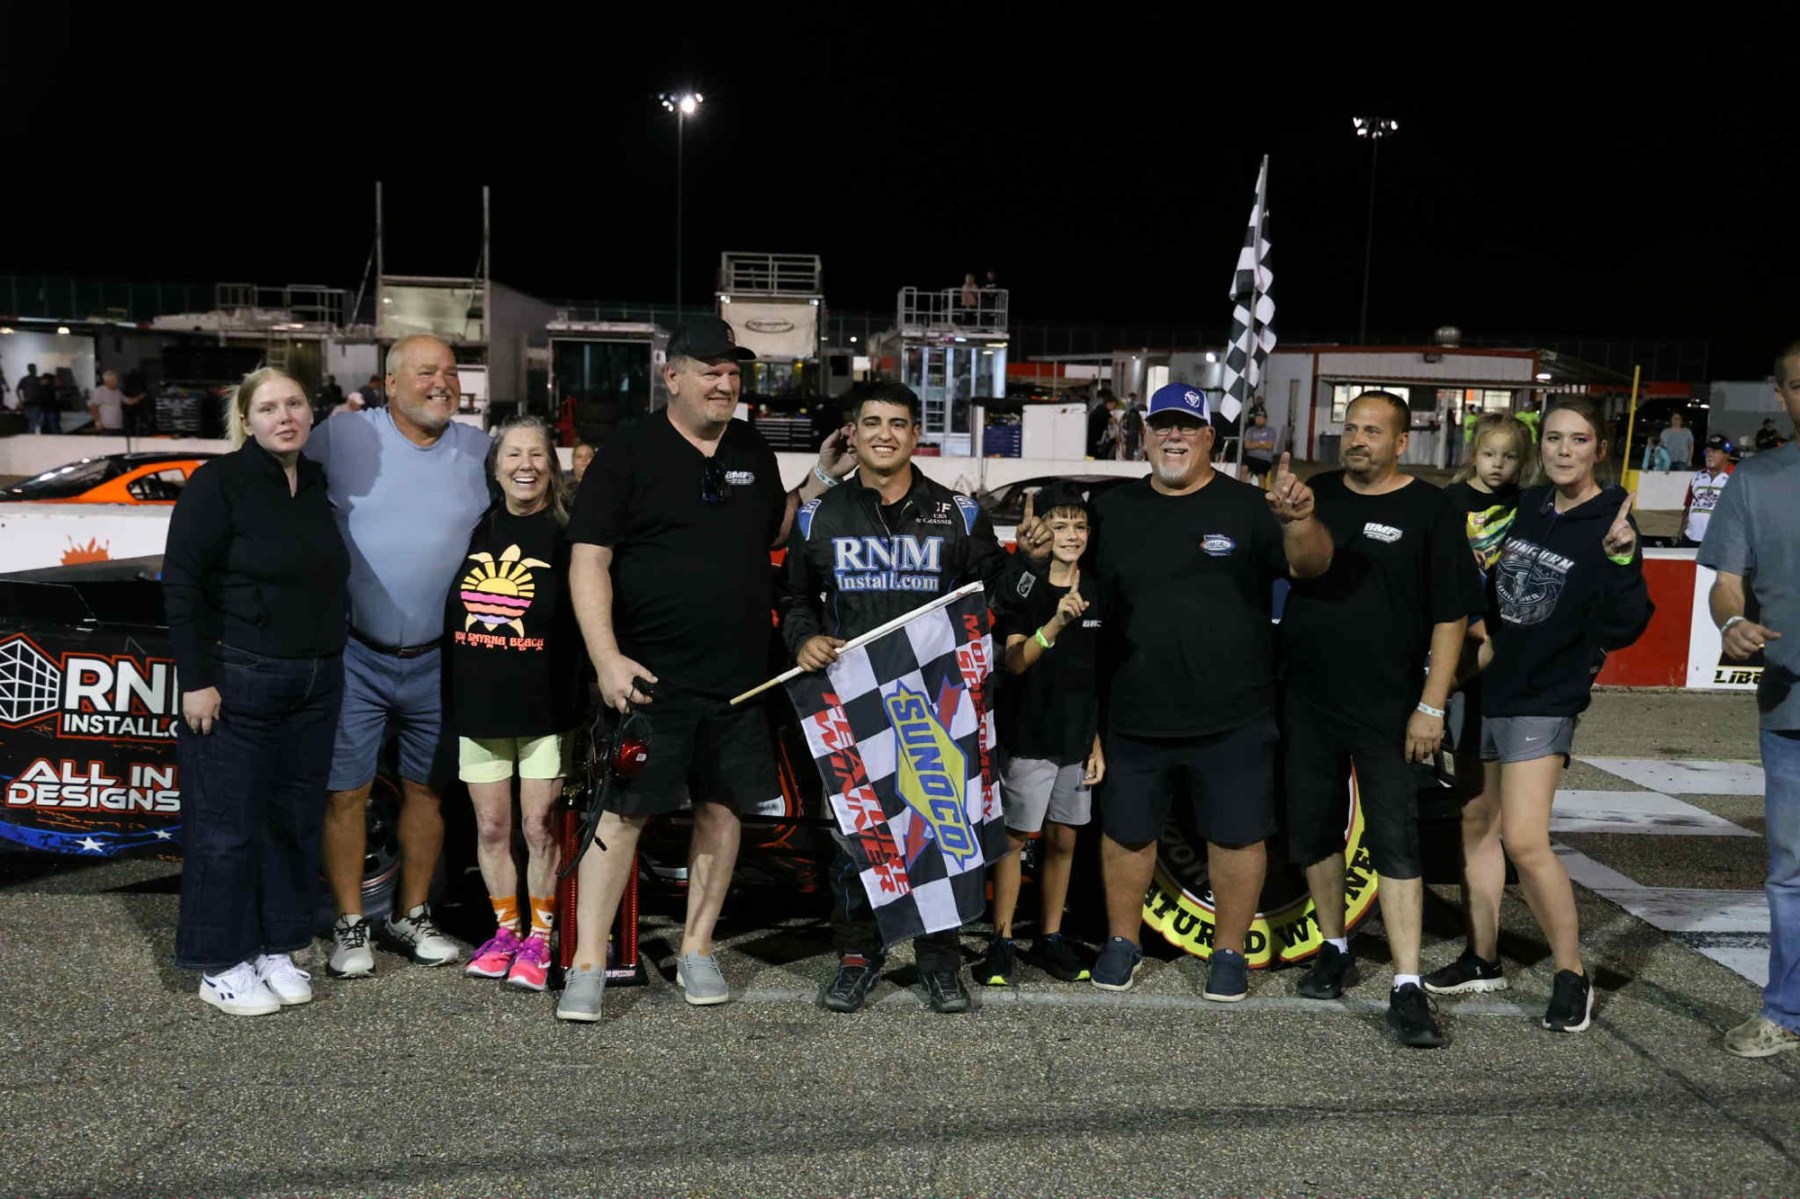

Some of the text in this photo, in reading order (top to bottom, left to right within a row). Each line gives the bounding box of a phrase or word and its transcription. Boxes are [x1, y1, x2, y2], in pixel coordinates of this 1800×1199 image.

[832, 536, 944, 572] RNM
[835, 572, 939, 591] Install.com
[510, 637, 544, 648] BEACH
[65, 658, 178, 715] RN
[20, 760, 173, 789] ALL IN
[891, 698, 970, 851] SUNOCO
[8, 782, 181, 812] DESIGNS
[814, 710, 896, 894] WINNER
[823, 692, 912, 894] FEATURE
